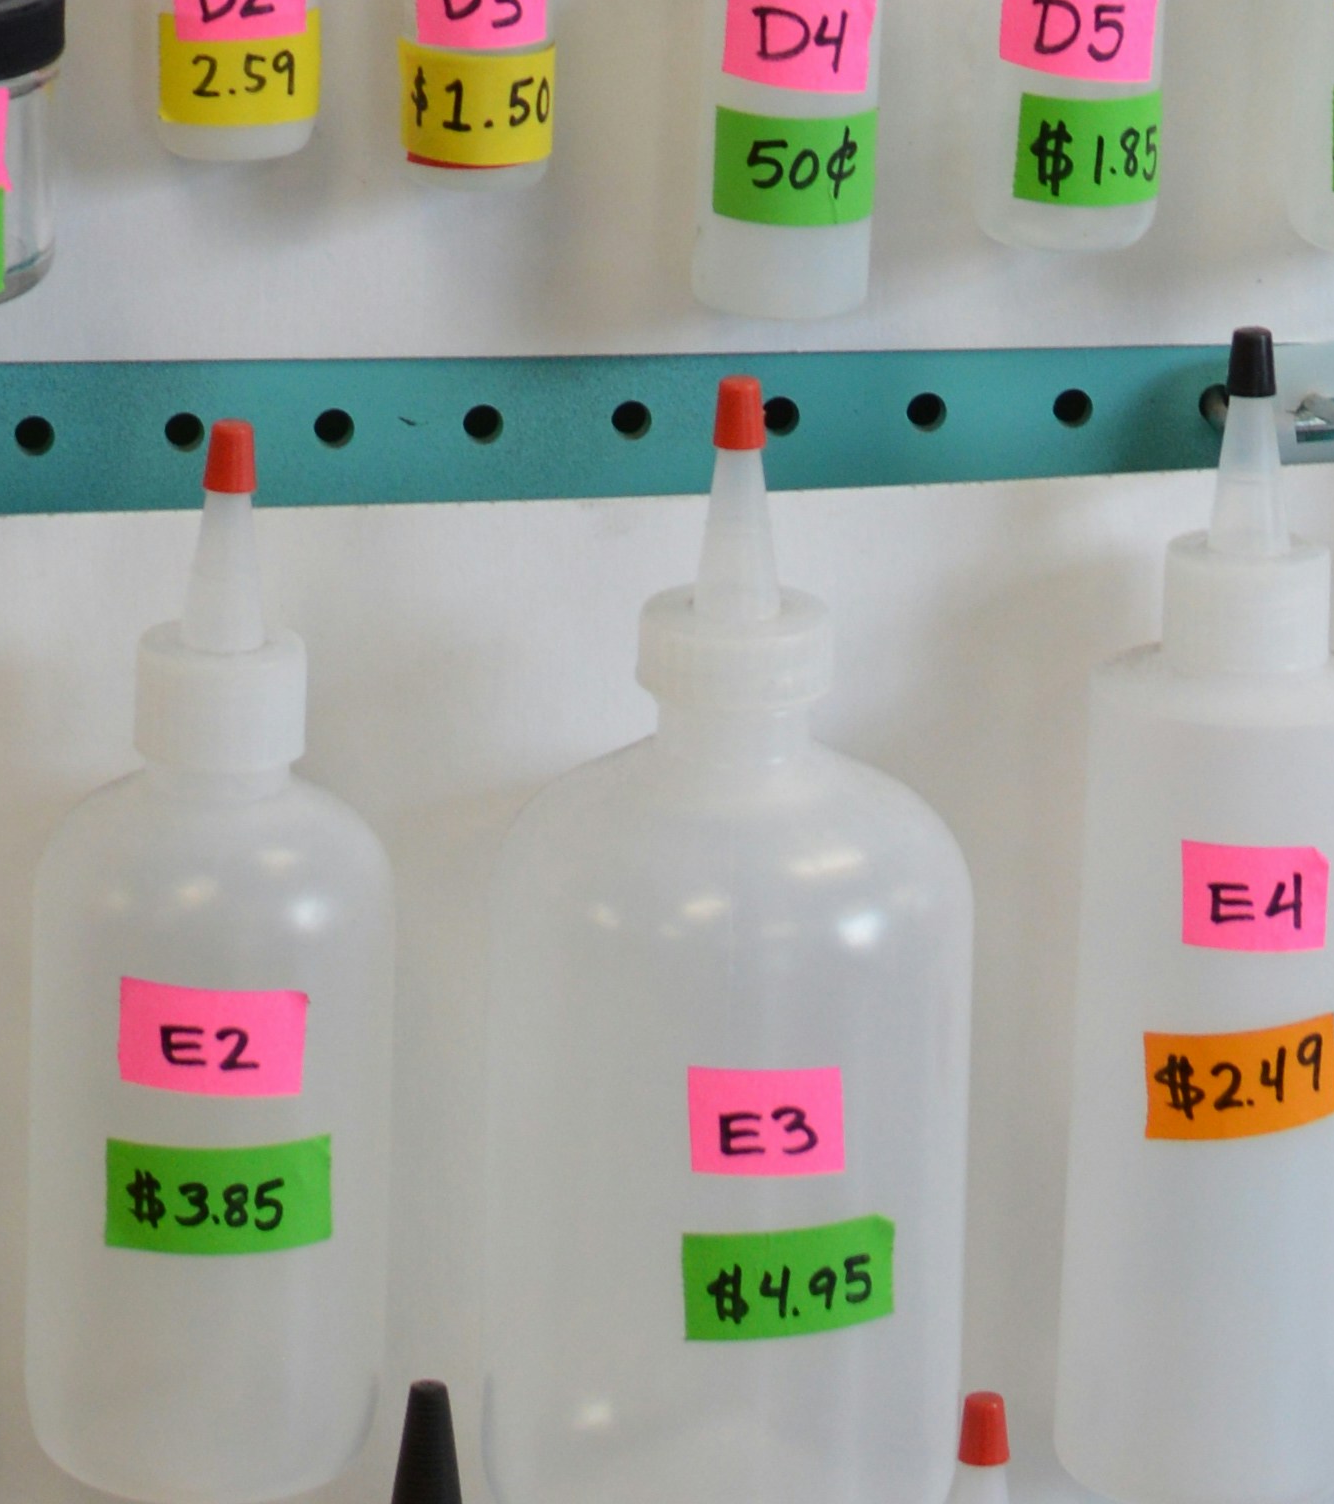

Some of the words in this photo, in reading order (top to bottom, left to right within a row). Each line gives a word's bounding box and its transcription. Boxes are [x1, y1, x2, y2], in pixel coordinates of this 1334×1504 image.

[189, 47, 298, 101] 2.59
[752, 5, 849, 74] D4
[408, 64, 551, 134] $1.50
[746, 126, 858, 198] 50¢
[1028, 118, 1159, 196] $1.85
[1205, 871, 1307, 931] E4
[157, 1023, 261, 1074] E2
[1155, 1030, 1324, 1120] $2.49
[717, 1103, 821, 1159] E3
[124, 1168, 286, 1233] $3.85
[706, 1251, 874, 1325] $4.95
